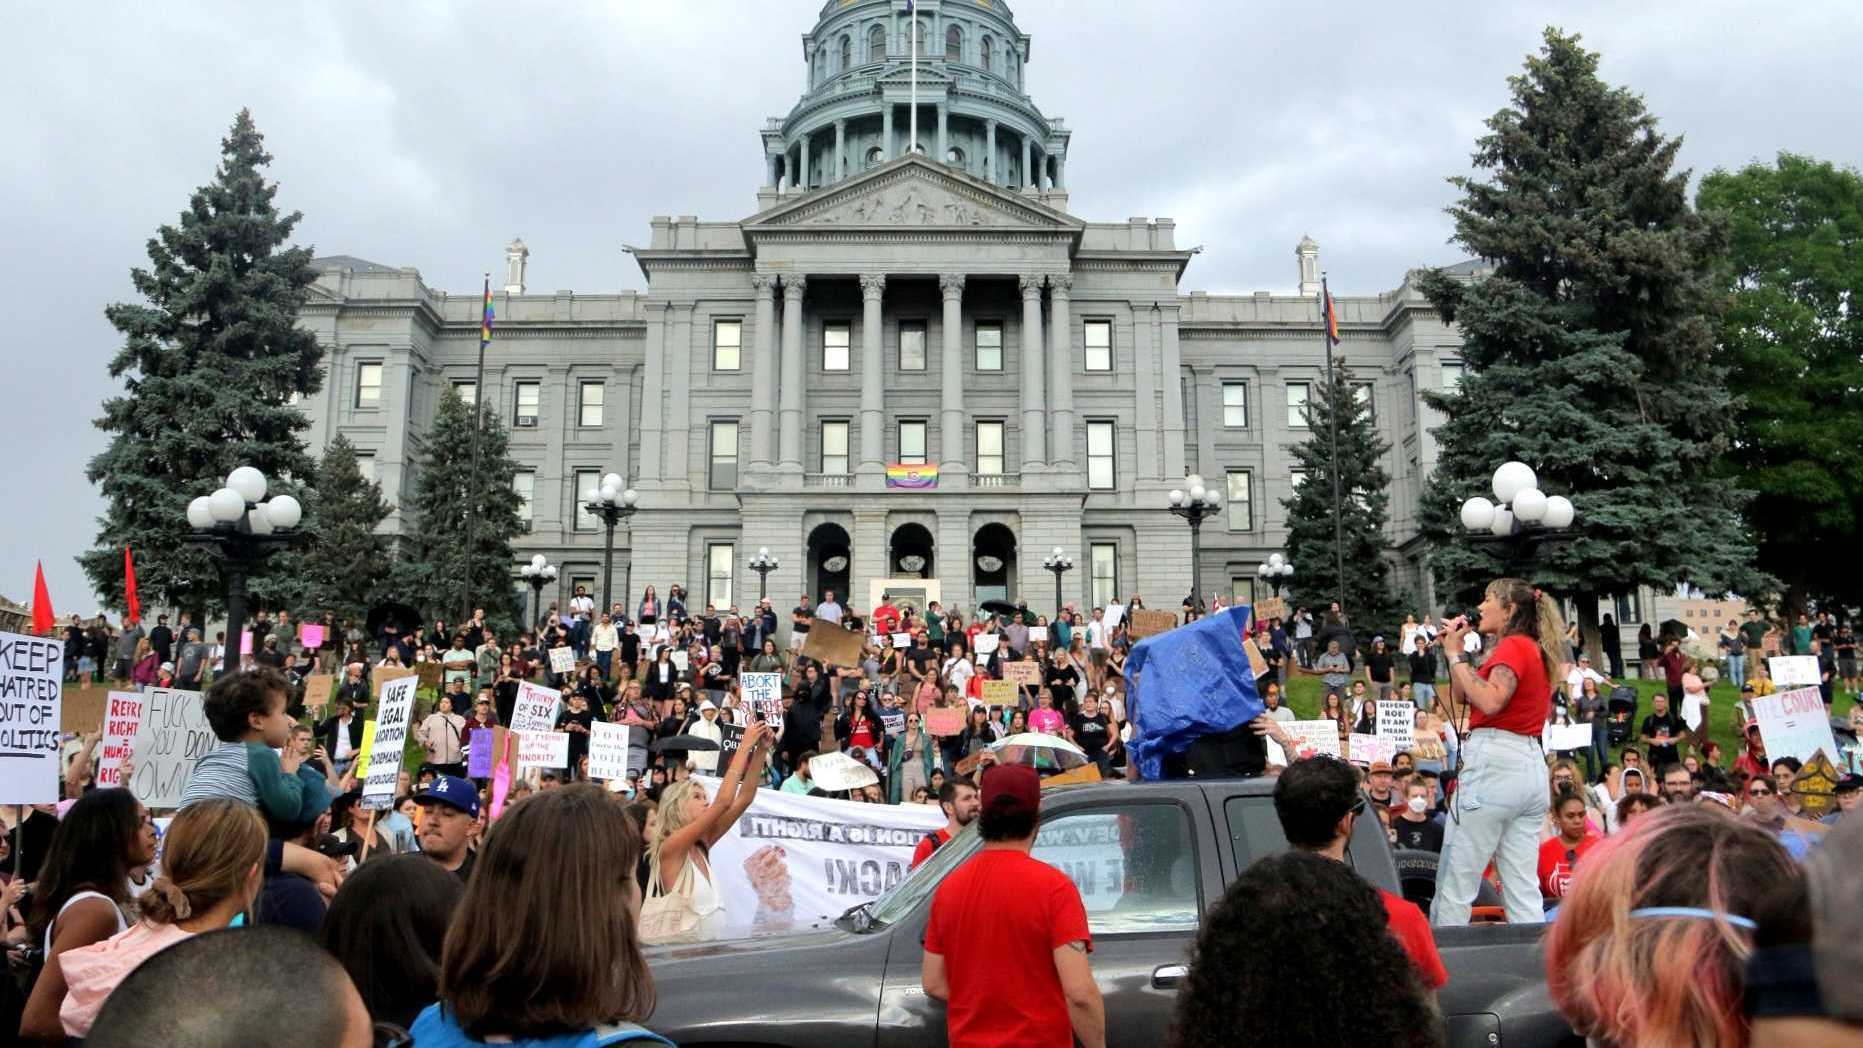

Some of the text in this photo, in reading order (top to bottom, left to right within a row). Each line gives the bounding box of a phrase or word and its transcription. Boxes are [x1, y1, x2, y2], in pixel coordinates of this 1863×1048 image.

[0, 641, 59, 673] KEEP
[741, 674, 779, 689] ABORT
[386, 685, 408, 703] SAFE
[748, 688, 772, 701] THE
[30, 705, 52, 725] OF
[149, 691, 191, 729] FUCK
[380, 707, 405, 726] LEGAL
[530, 704, 552, 719] SIX
[1, 728, 60, 751] OLITICS
[147, 730, 218, 758] YOU DON
[104, 745, 134, 759] HUMA
[100, 768, 121, 784] RIG
